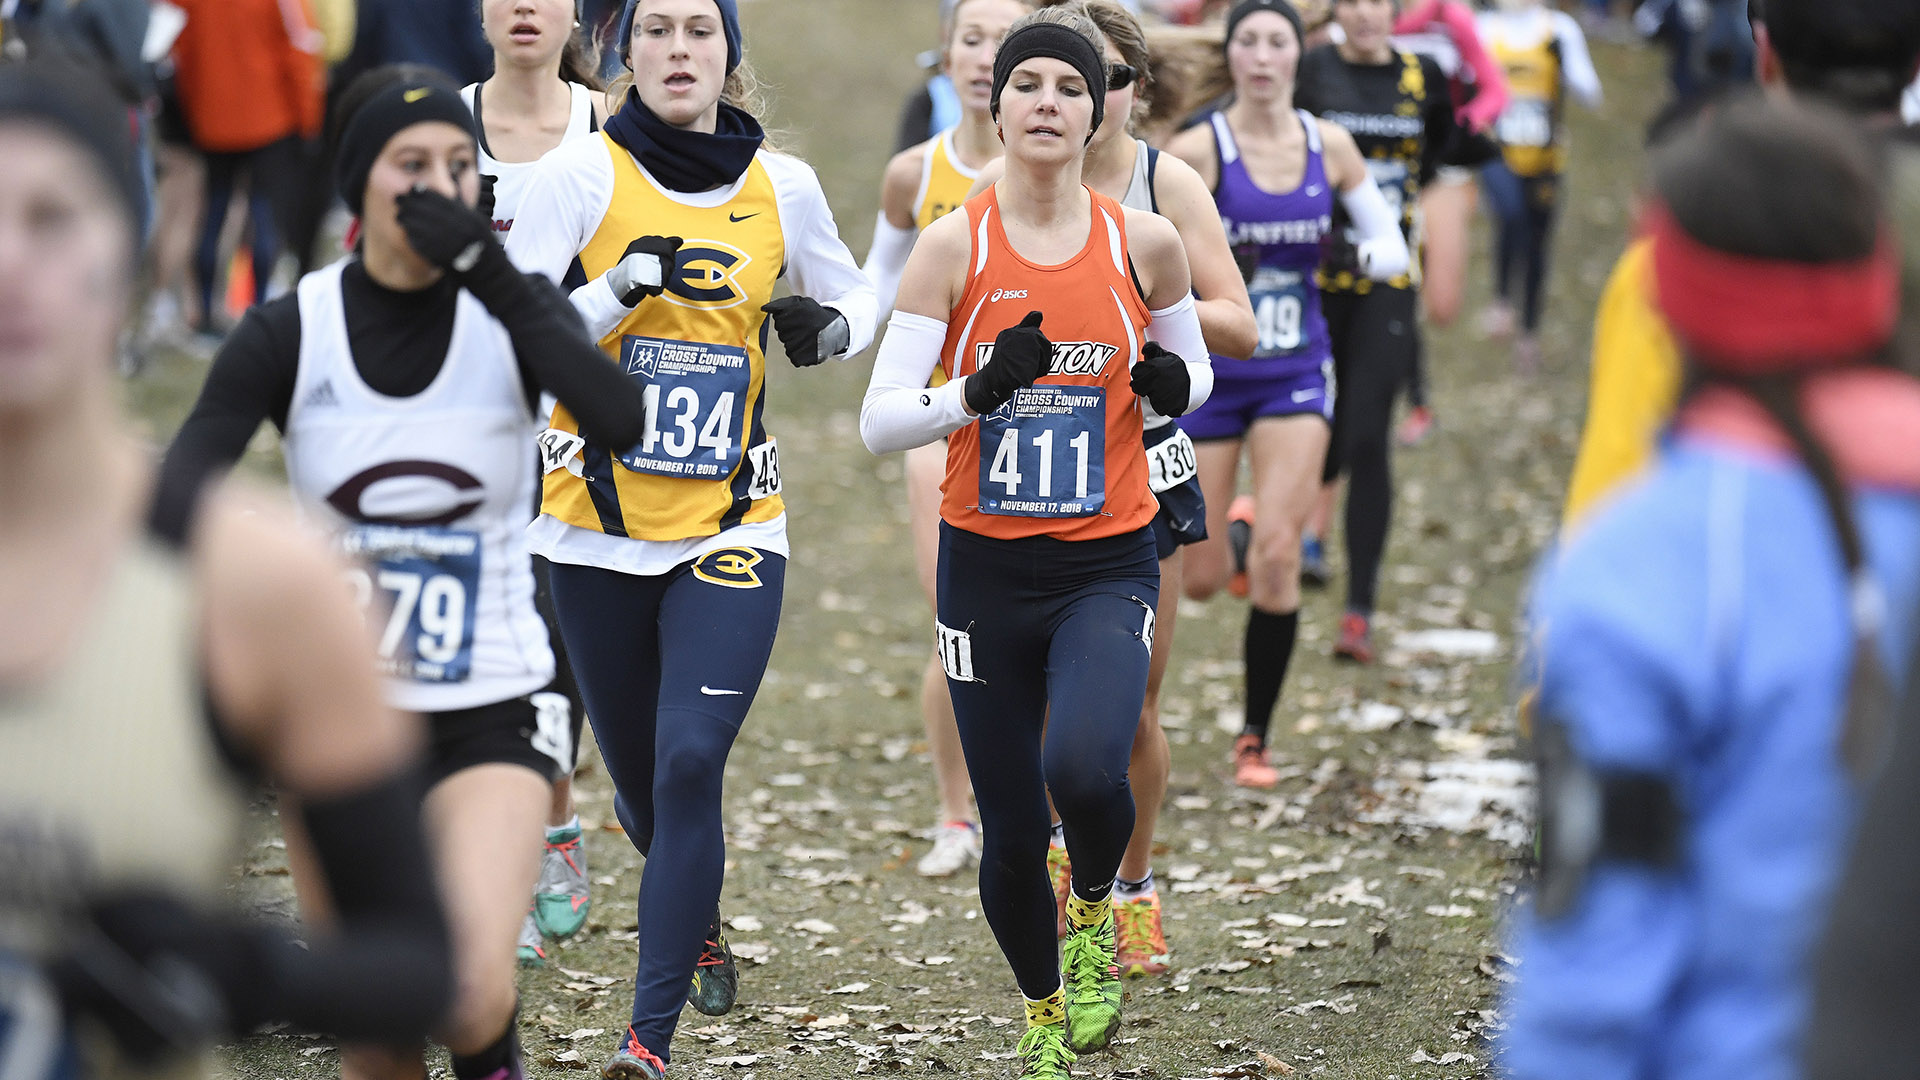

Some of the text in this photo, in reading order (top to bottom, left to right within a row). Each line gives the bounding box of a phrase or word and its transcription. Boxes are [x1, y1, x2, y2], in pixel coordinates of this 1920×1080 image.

[1002, 289, 1028, 299] asics
[658, 360, 718, 375] CHAMPIONSHIPS
[661, 349, 745, 368] CROSS COUNTRY
[976, 340, 1120, 377] WTON
[1017, 393, 1100, 408] CROSS COUNTRY
[1015, 406, 1073, 415] CHAMPIONSHIPS
[633, 456, 719, 476] NOVEMBER 17, 2018
[756, 445, 781, 494] 43
[989, 428, 1090, 499] 411
[1155, 437, 1195, 484] 130
[1000, 500, 1082, 514] NOVEMBER 17, 2018
